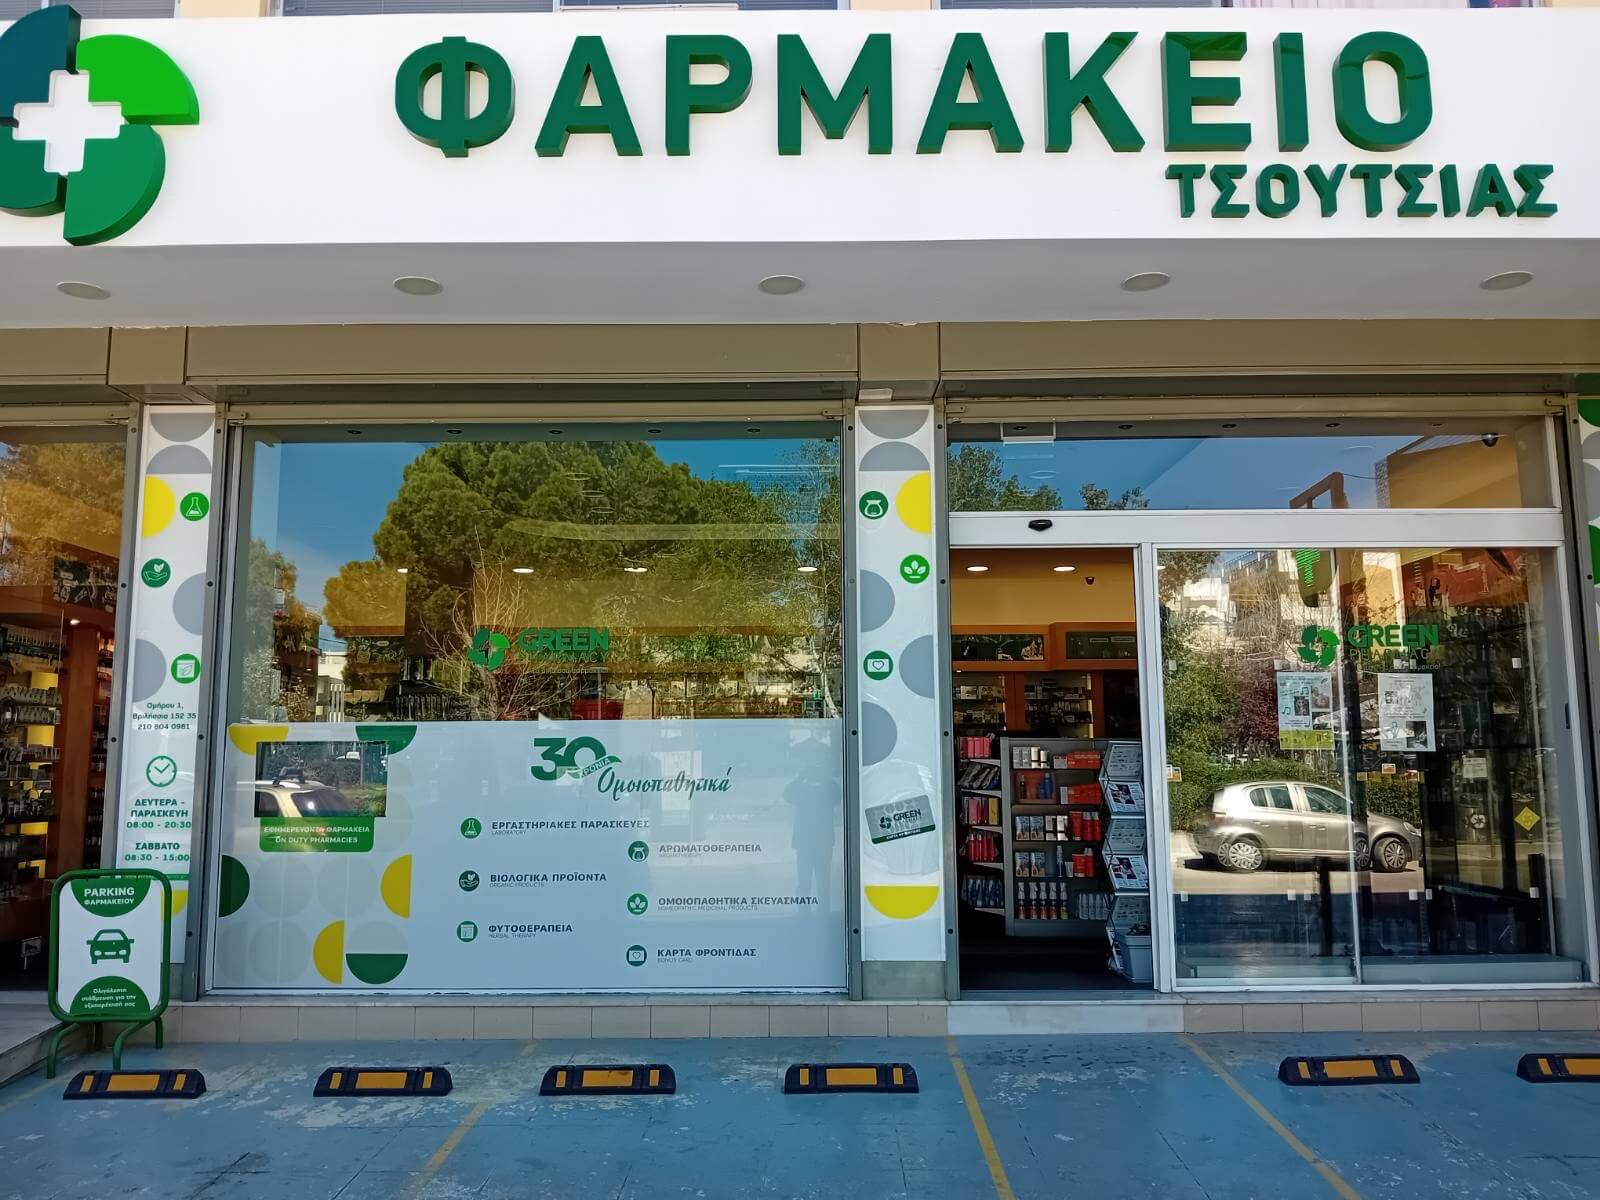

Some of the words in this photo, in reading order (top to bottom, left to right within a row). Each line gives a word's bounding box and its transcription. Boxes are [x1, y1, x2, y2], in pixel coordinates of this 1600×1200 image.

[394, 31, 1433, 158] ΦΑΡΜΑΚΕΙΟ
[1165, 163, 1558, 219] ΤΣΟΥΤΣΙΑΣ
[517, 627, 609, 651] GREEN
[1347, 623, 1439, 648] GREEN
[147, 702, 175, 710] Ομήρου
[177, 702, 184, 710] 1,
[531, 736, 607, 781] 30
[597, 767, 732, 801] Ομοιοπαθητικά
[134, 798, 178, 806] ΔΕΥΤΕΡΑ
[130, 810, 188, 818] ΠΑΡΑΣΚΕΥΗ
[893, 808, 922, 822] GREEN
[164, 821, 192, 829] 20:30
[491, 821, 577, 830] ΕΡΓΑΣΤΗΡΙΑΚΕΣ
[580, 820, 650, 829] ΠΑΡΑΣΚΕΥΕΣ
[135, 842, 180, 850] ΣΑΒΒΑΤΟ
[659, 844, 762, 853] ΑΡΩΜΑΤΟΘΕΡΑΠΕΙΑ
[124, 854, 152, 862] 08:30
[163, 854, 190, 862] 15:00
[490, 874, 549, 882] ΒΙΟΛΟΓΙΚΑ
[552, 871, 607, 882] ΠΡΟΪΟΝΤΑ
[84, 887, 135, 897] PARKING
[658, 897, 747, 906] ΟΜΟΙΟΠΑΘΗΤΙΚΑ
[750, 896, 819, 905] ΣΚΕΥΑΣΜΑΤΑ
[488, 924, 573, 933] ΦΥΤΟΘΕΡΑΠΕΙΑ
[657, 948, 692, 957] ΚΑΡΤΑ
[695, 948, 757, 957] ΦΡΟΝΤΙΔΑΣ
